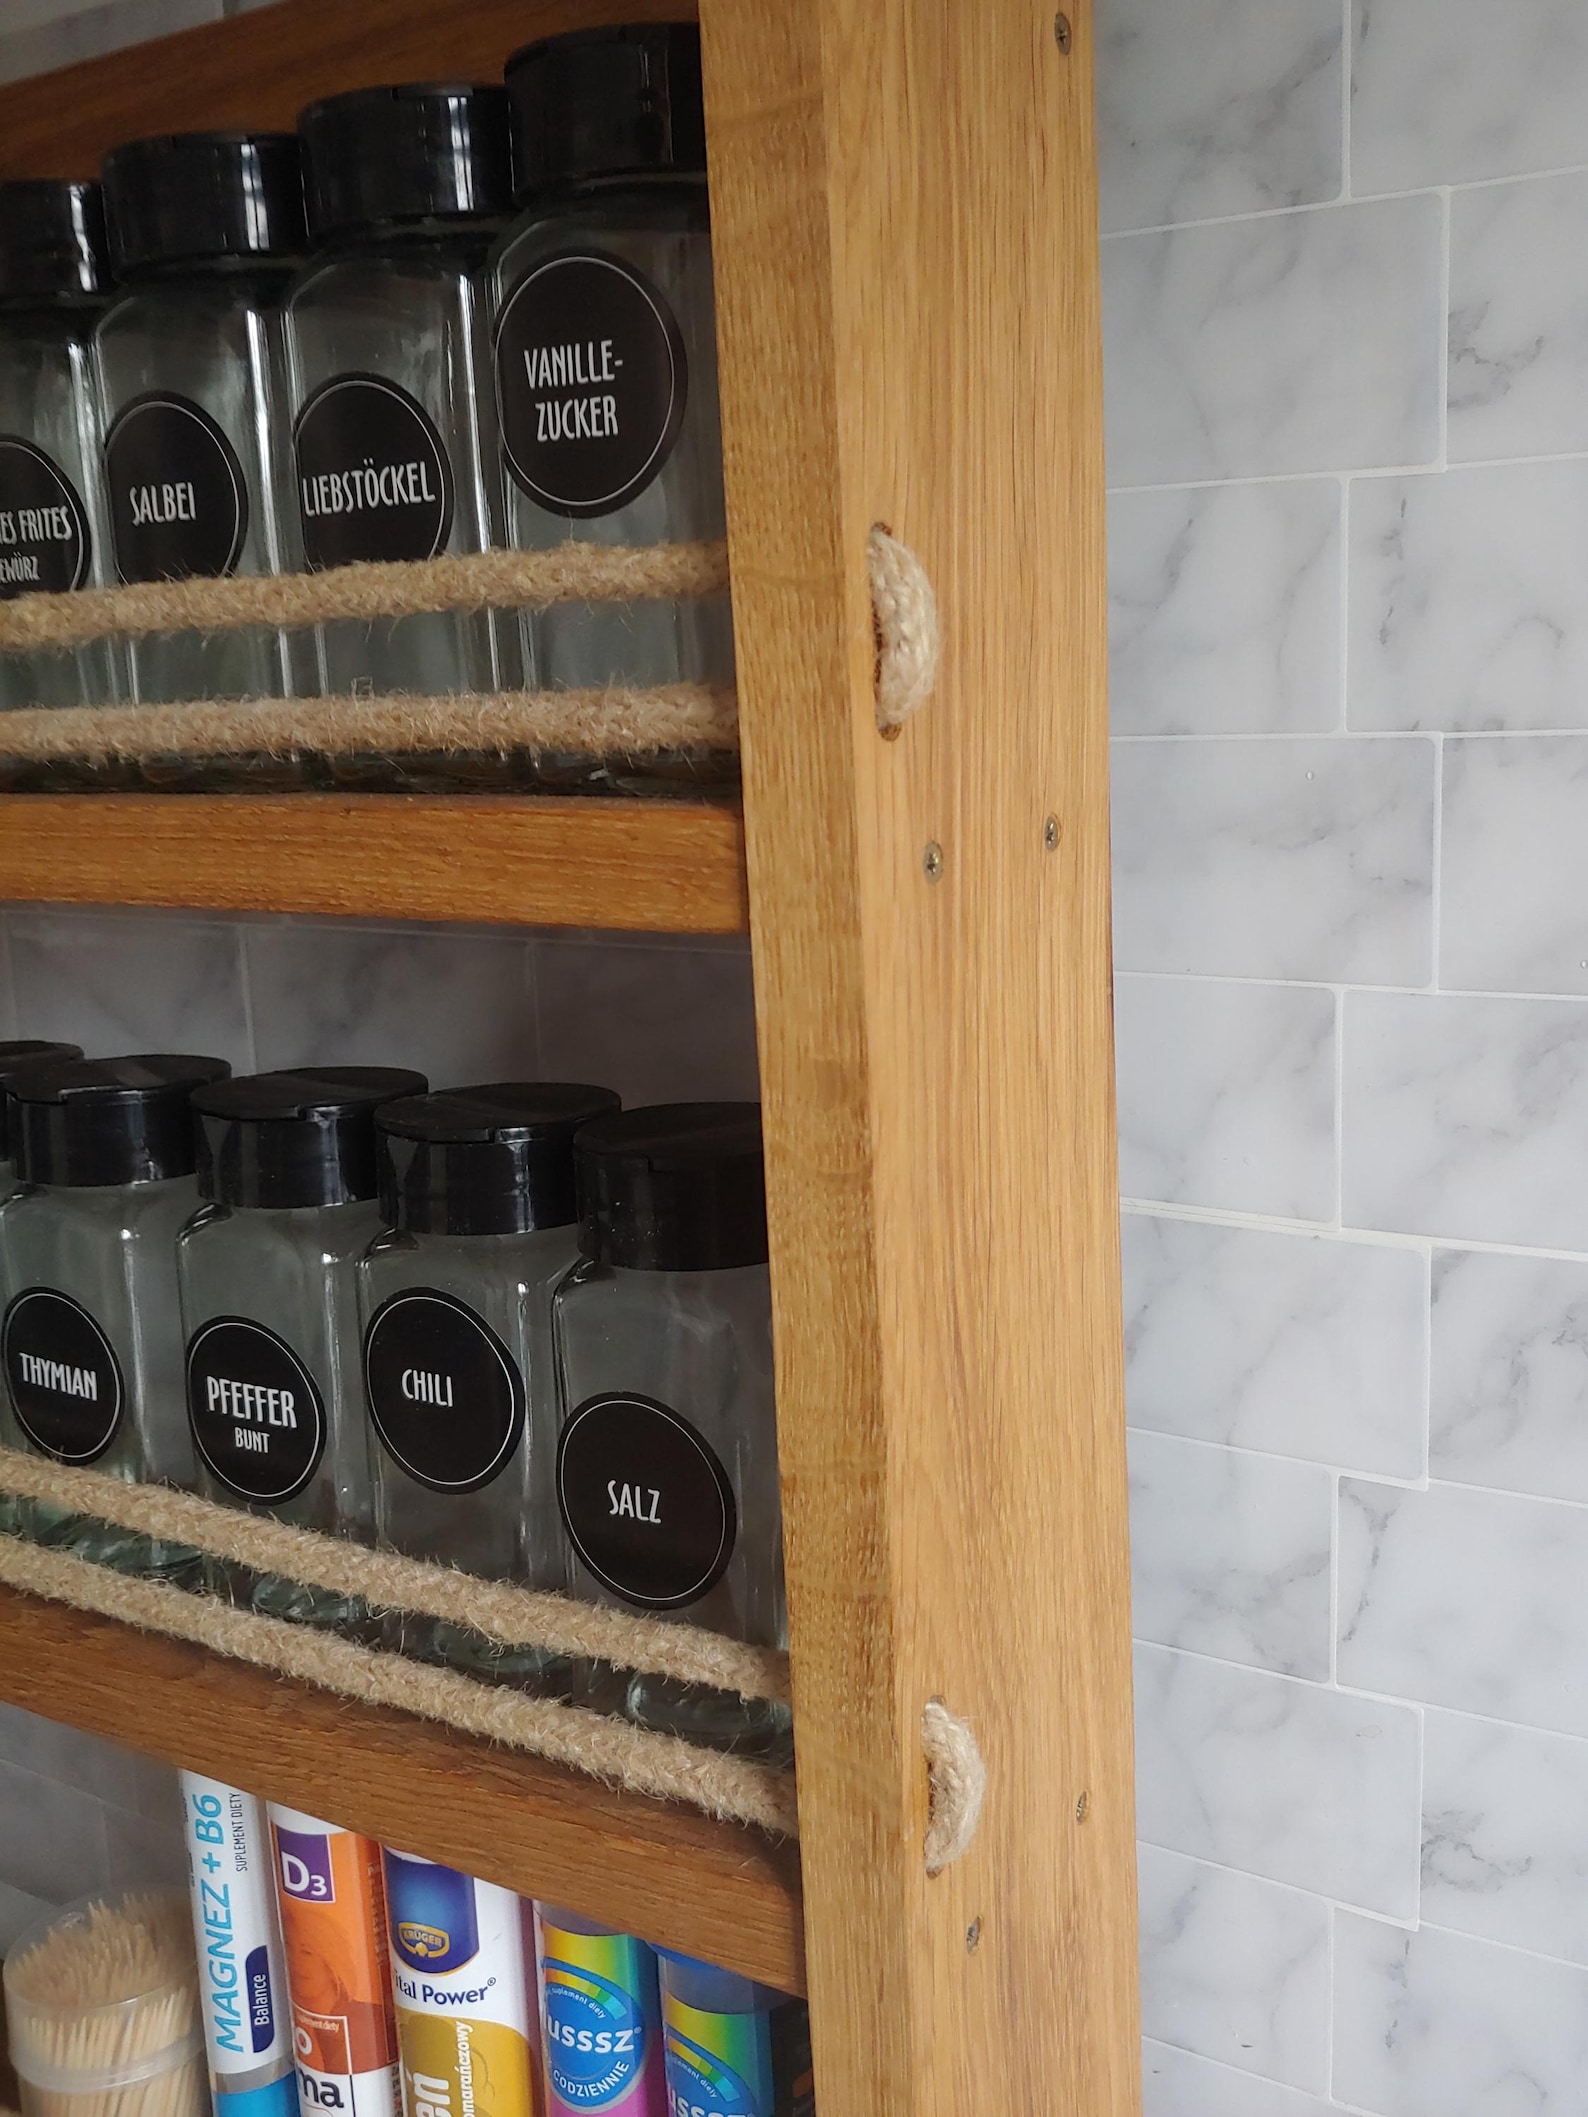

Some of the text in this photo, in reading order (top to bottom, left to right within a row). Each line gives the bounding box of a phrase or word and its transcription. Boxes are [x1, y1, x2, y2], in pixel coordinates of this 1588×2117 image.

[524, 339, 624, 389] VANILLE-
[534, 394, 619, 442] ZUCKER
[129, 481, 197, 526] SALBEI
[302, 457, 436, 518] LIEBSTÖCKEL
[18, 505, 72, 543] FRITES
[19, 1352, 97, 1401] THYMIAN
[402, 1368, 453, 1408] CHILI
[207, 1375, 297, 1430] PFEFFER
[234, 1426, 270, 1454] BUNT
[607, 1479, 661, 1524] SALZ
[192, 1794, 224, 1844] B6
[229, 1793, 248, 1872] SUPLEMENT DIETY
[201, 1879, 244, 2053] MAGNEZ
[394, 1967, 417, 2000] ital
[253, 1974, 270, 2026] Balance
[547, 2015, 635, 2053] usssz
[553, 2061, 630, 2098] CODZIENNIE
